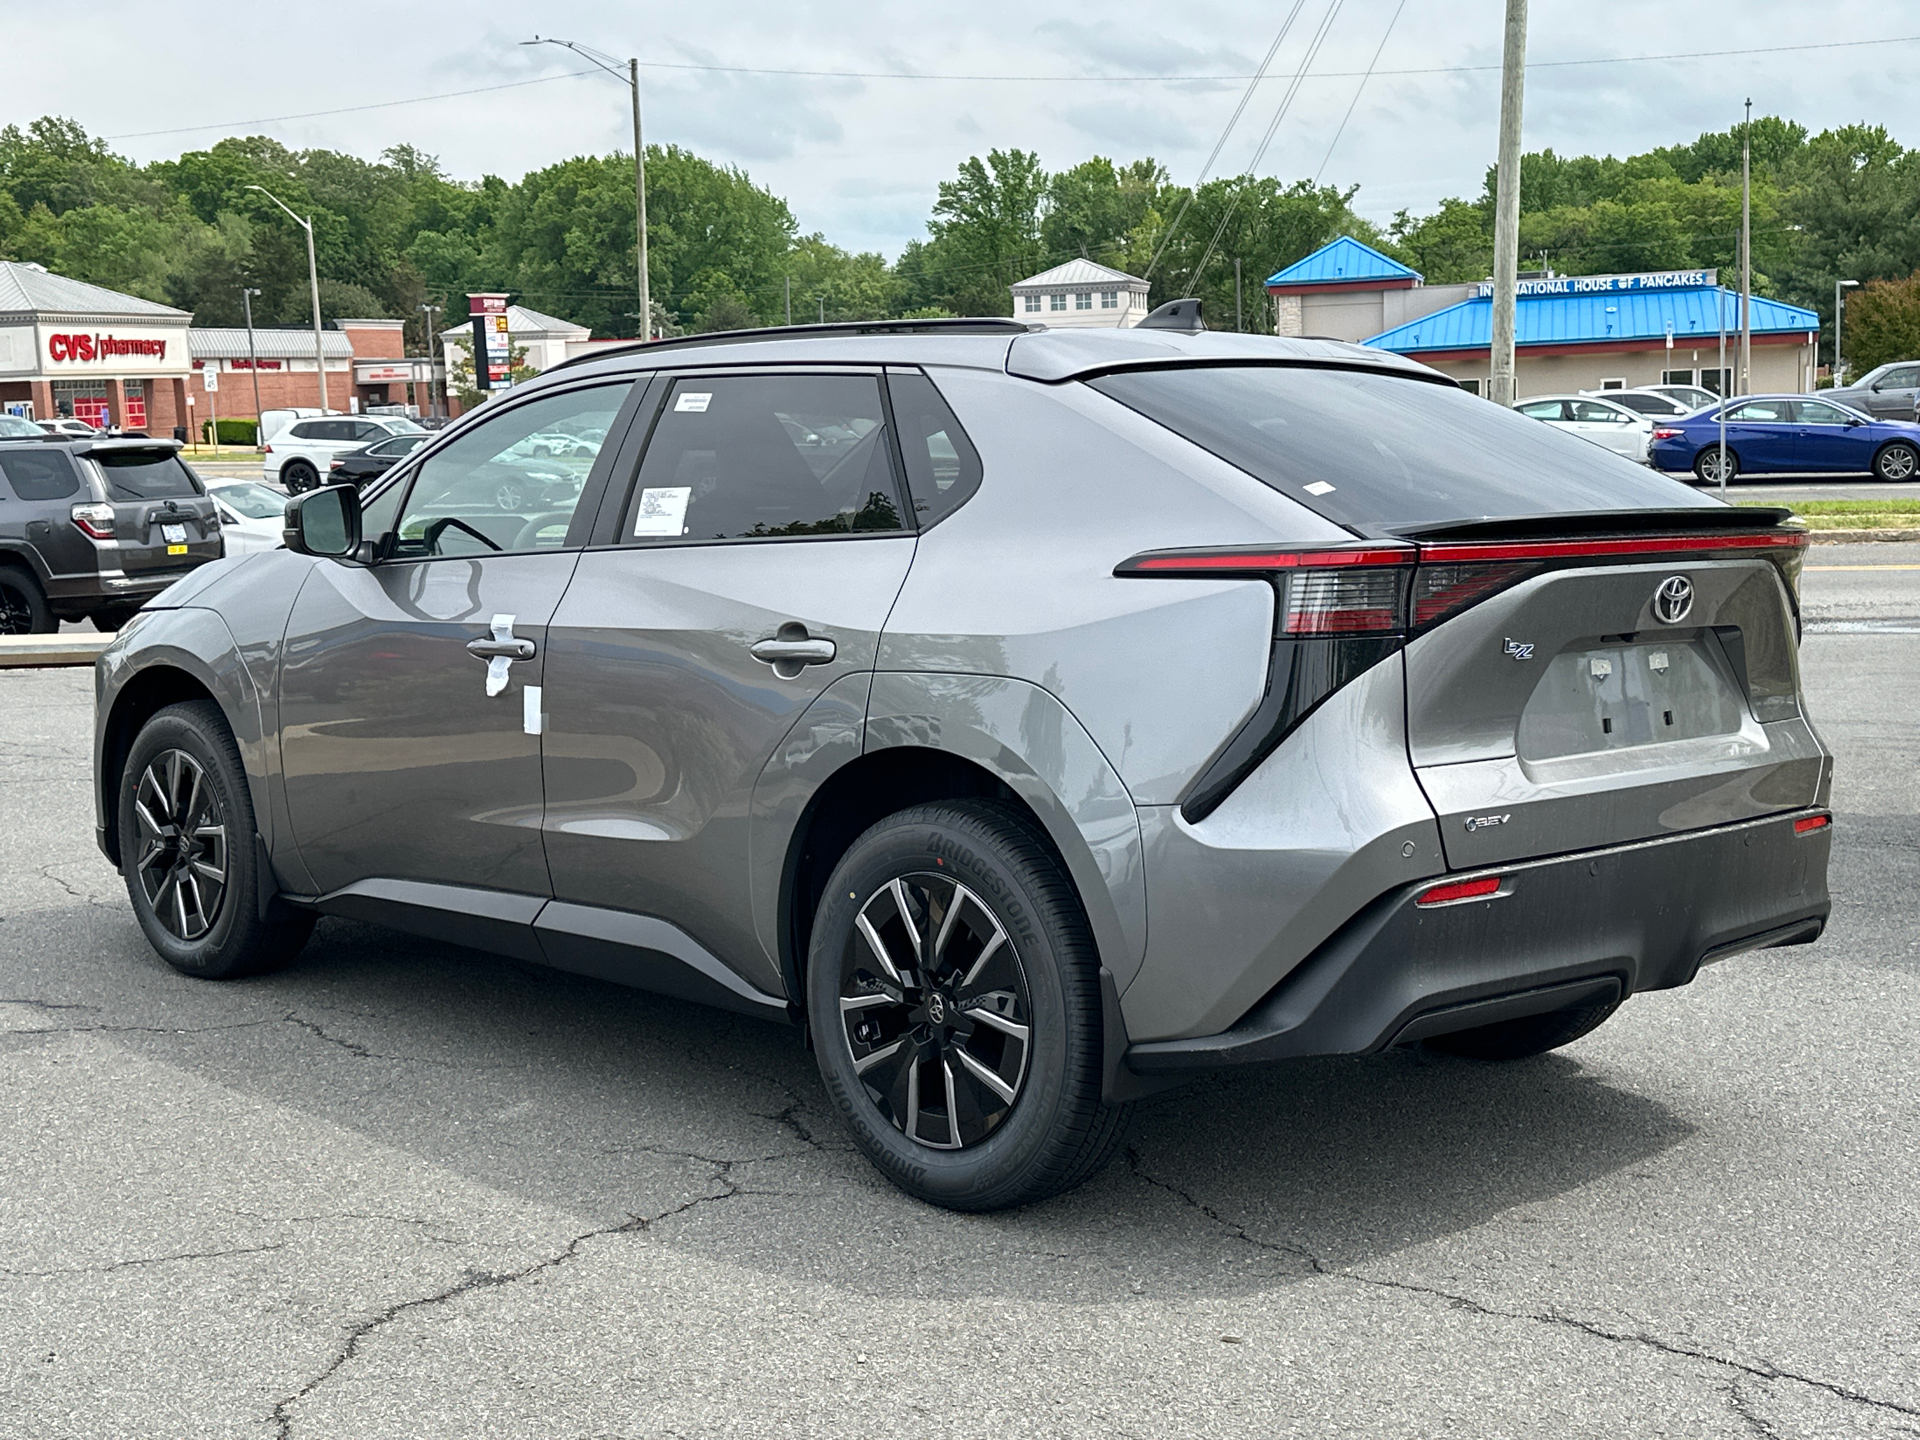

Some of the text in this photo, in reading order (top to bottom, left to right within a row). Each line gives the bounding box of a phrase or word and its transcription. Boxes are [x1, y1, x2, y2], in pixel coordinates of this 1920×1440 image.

[1479, 273, 1704, 297] INNATIONAL HOUSE OF PANCAKES
[49, 333, 166, 362] CVS/pharmacy
[926, 831, 1039, 948] BRIDGESTONE
[826, 1069, 928, 1188] BRIDGESTONE
